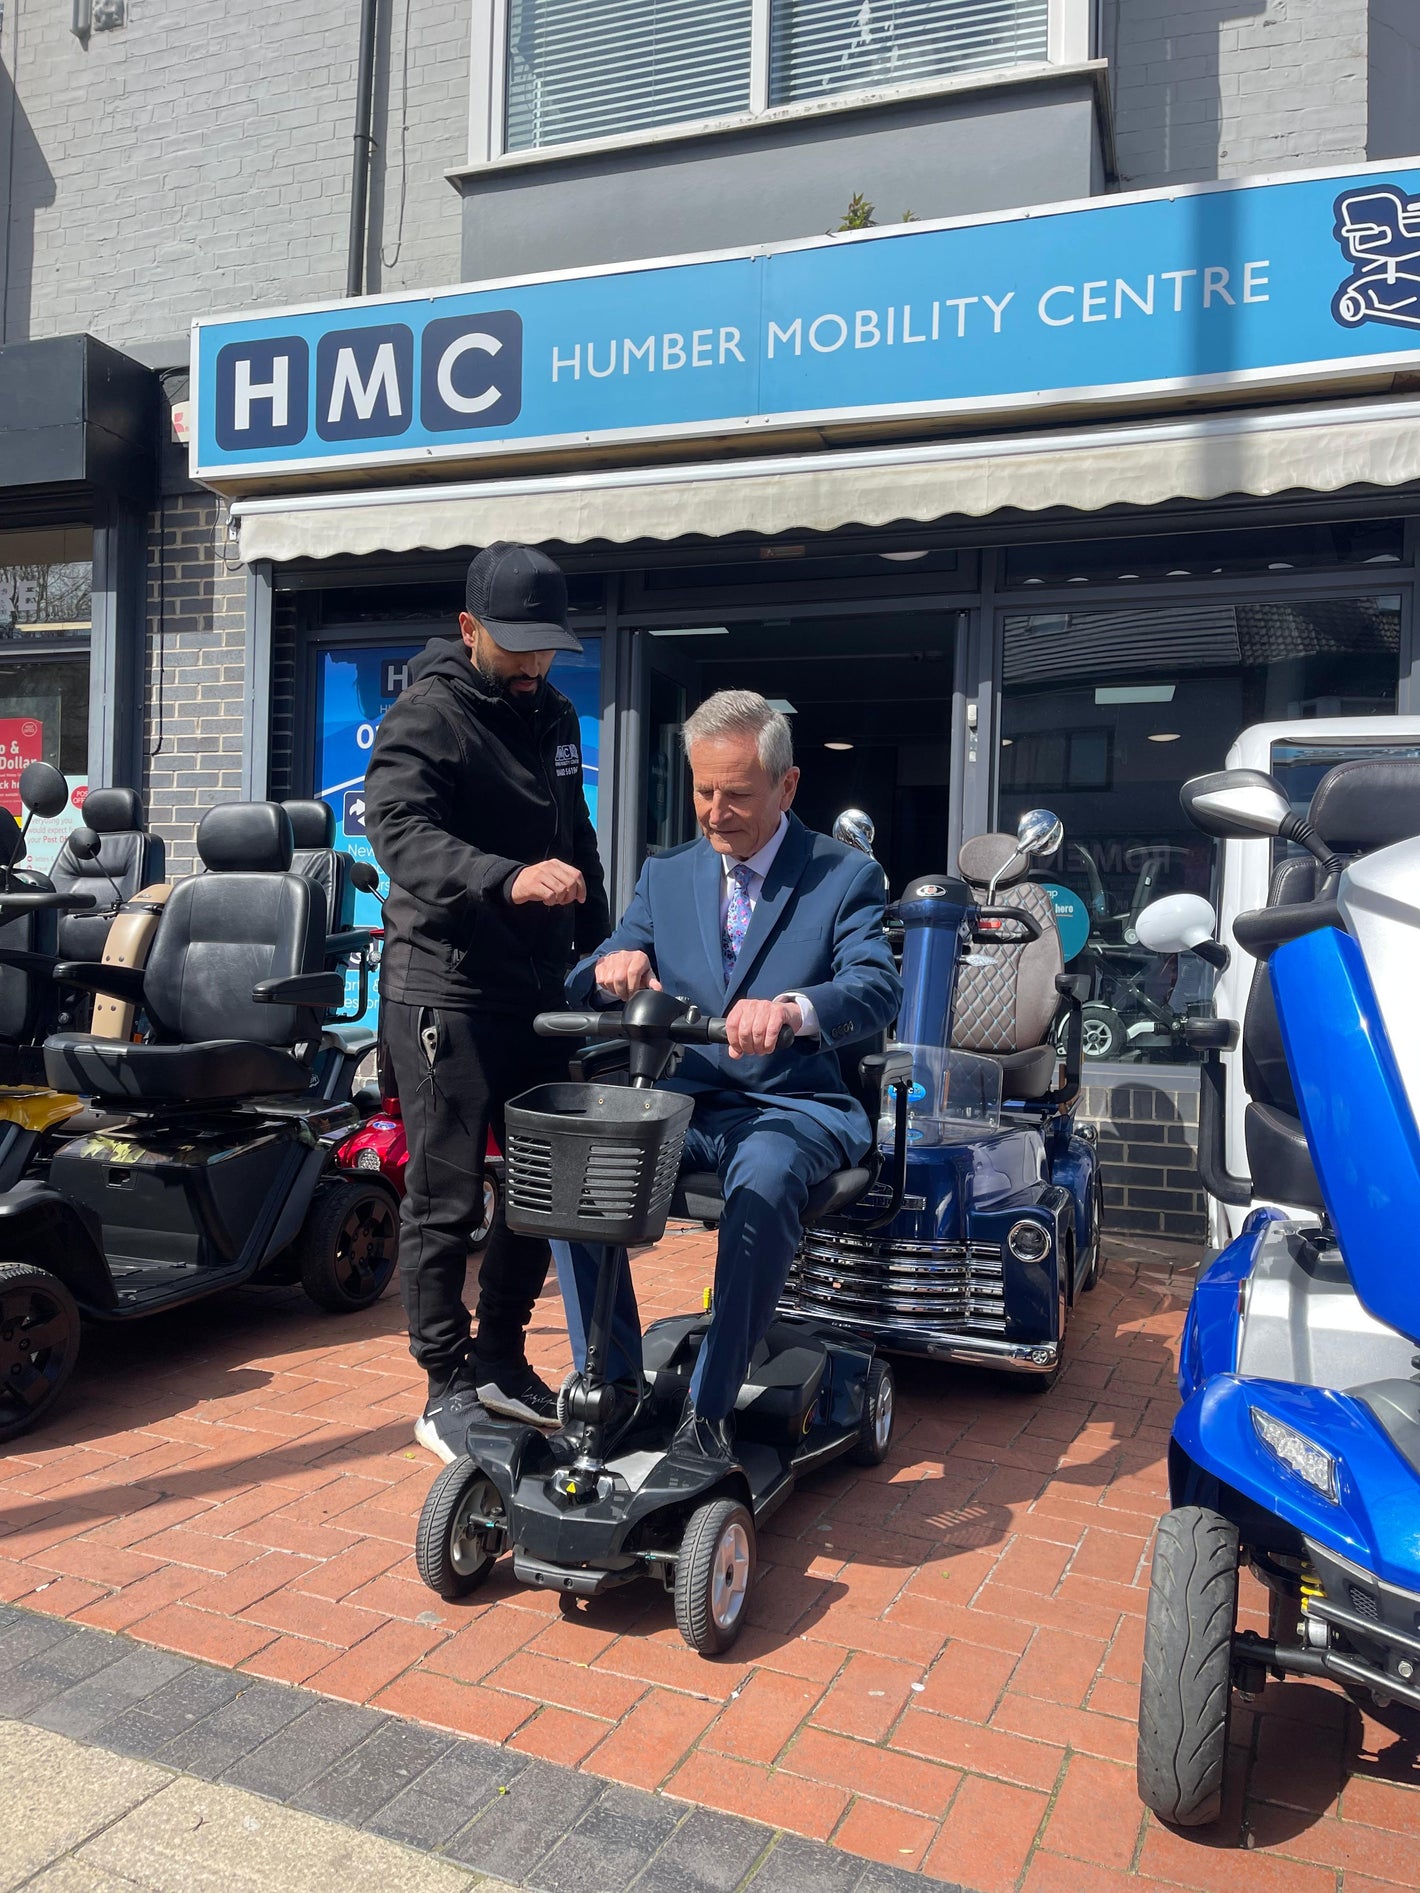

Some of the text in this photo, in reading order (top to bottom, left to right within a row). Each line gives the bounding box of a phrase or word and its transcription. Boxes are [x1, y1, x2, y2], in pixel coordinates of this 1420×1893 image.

[233, 261, 1270, 431] HMC HUMBER MOBILITY CENTRE
